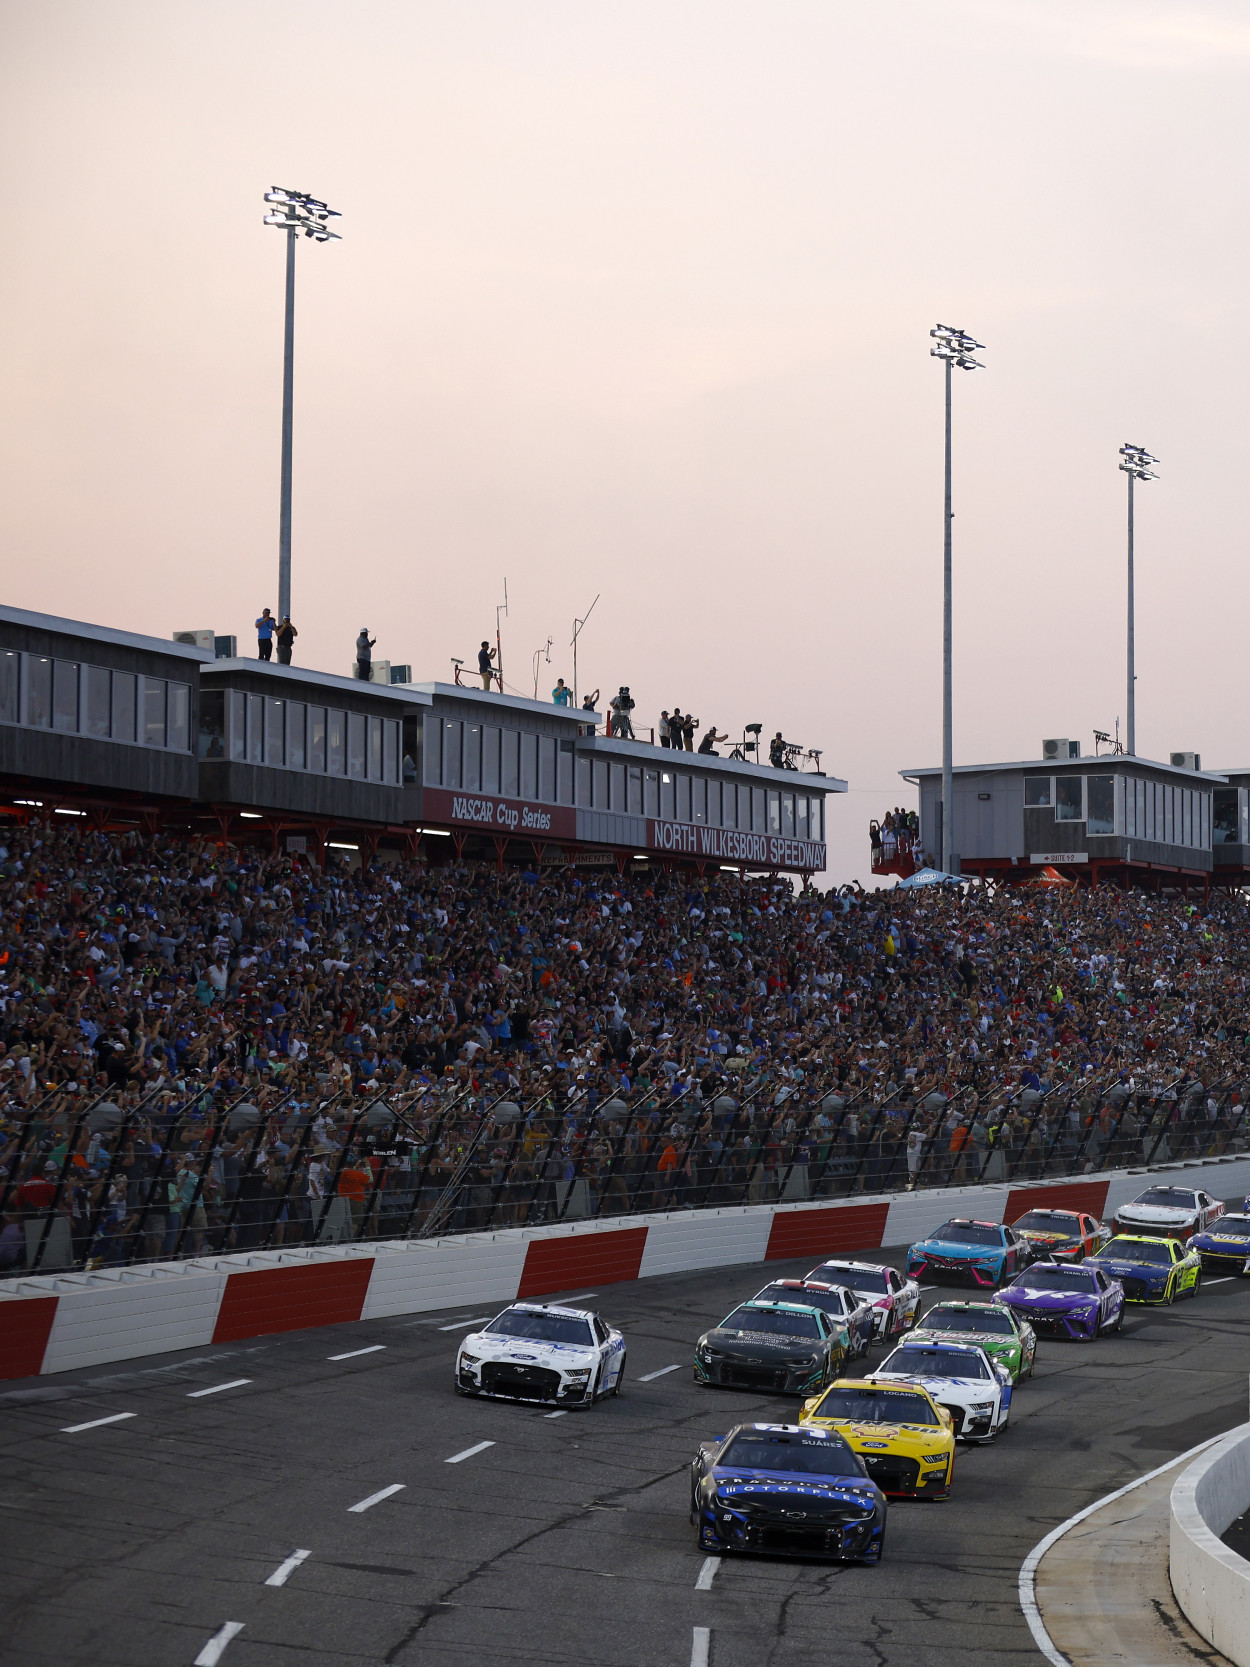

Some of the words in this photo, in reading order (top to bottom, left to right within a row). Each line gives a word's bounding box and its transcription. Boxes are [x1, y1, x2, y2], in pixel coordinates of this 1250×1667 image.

[452, 797, 493, 822] NASCAR
[497, 804, 519, 830] Cup
[521, 806, 551, 830] Series
[654, 821, 697, 852] NORTH
[700, 827, 767, 862] WILKESBORO
[770, 837, 826, 870] SPEEDWAY
[542, 854, 612, 864] REFREHMENTS
[785, 1311, 813, 1319] DILLON
[883, 1390, 917, 1398] LOGANO
[801, 1439, 843, 1449] SUÁREZ
